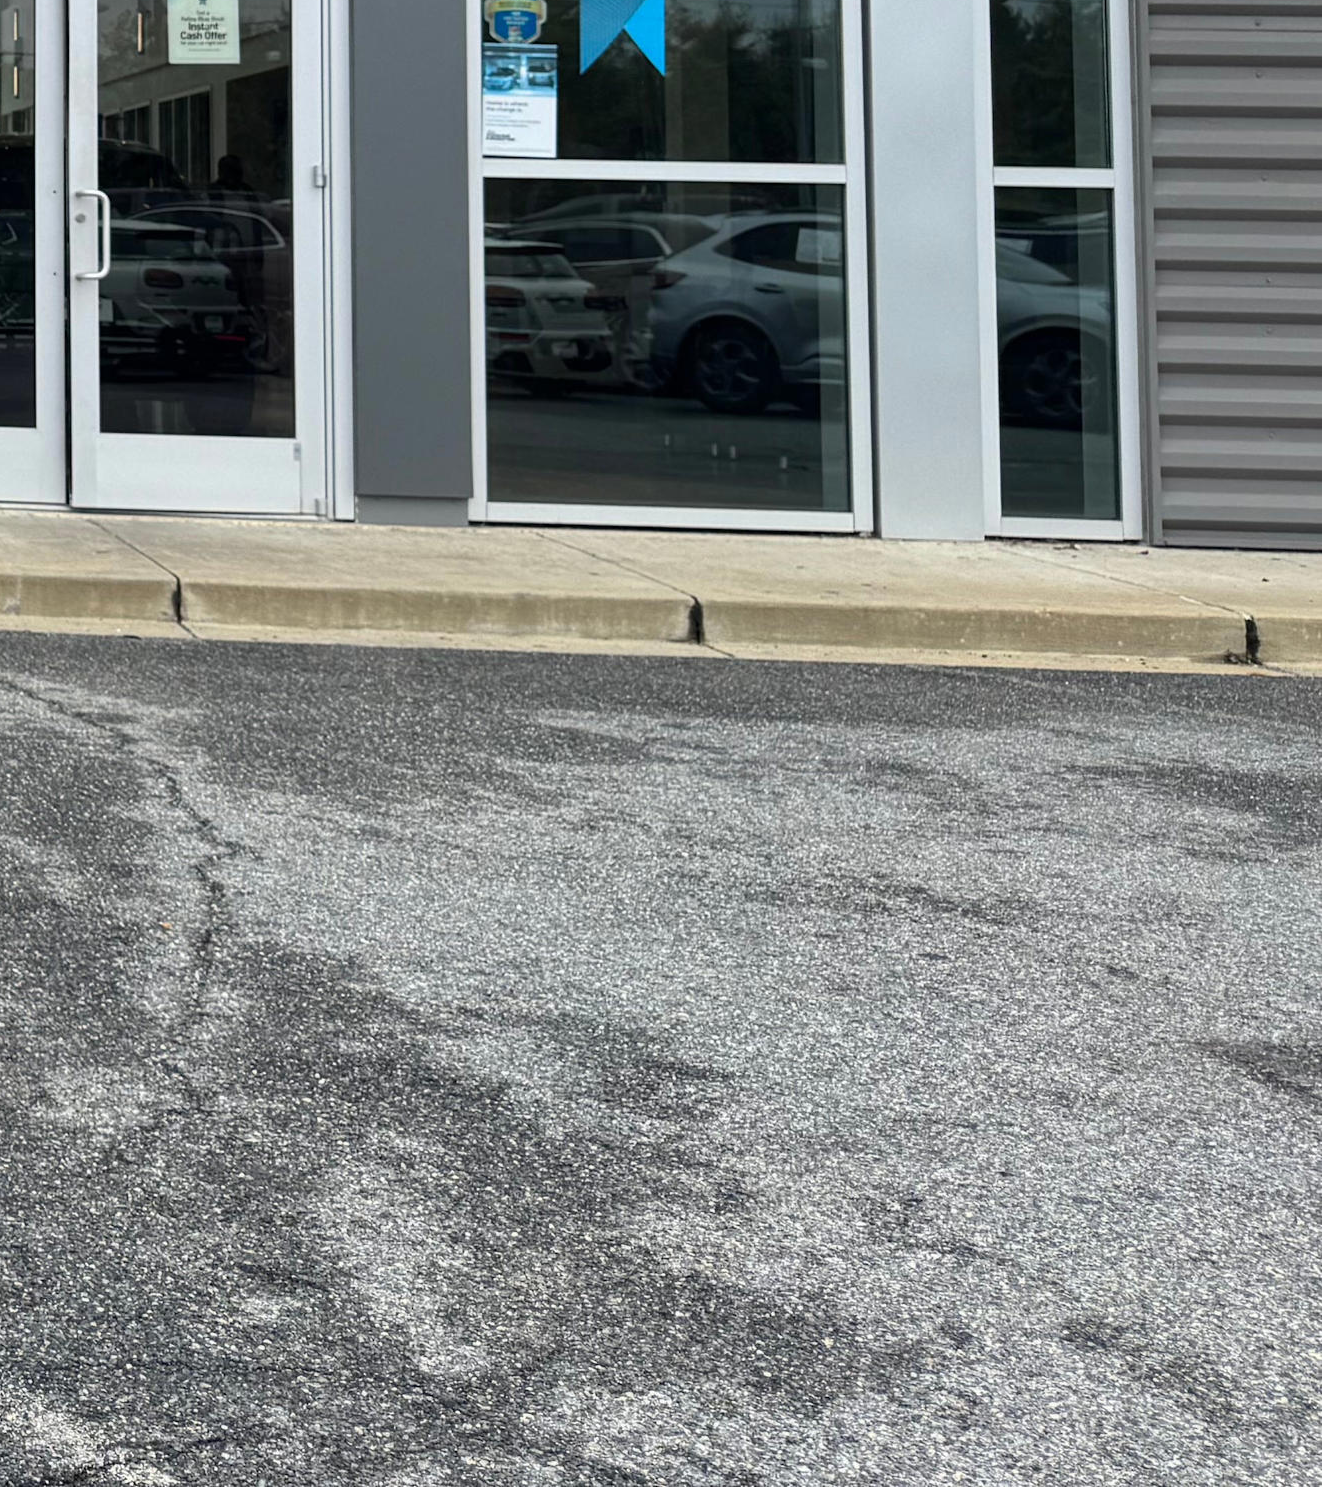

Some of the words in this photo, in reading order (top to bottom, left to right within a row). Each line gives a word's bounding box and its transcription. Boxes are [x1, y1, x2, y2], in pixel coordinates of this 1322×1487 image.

[188, 23, 219, 31] Instant
[180, 31, 203, 40] Cash
[205, 32, 227, 40] Offer
